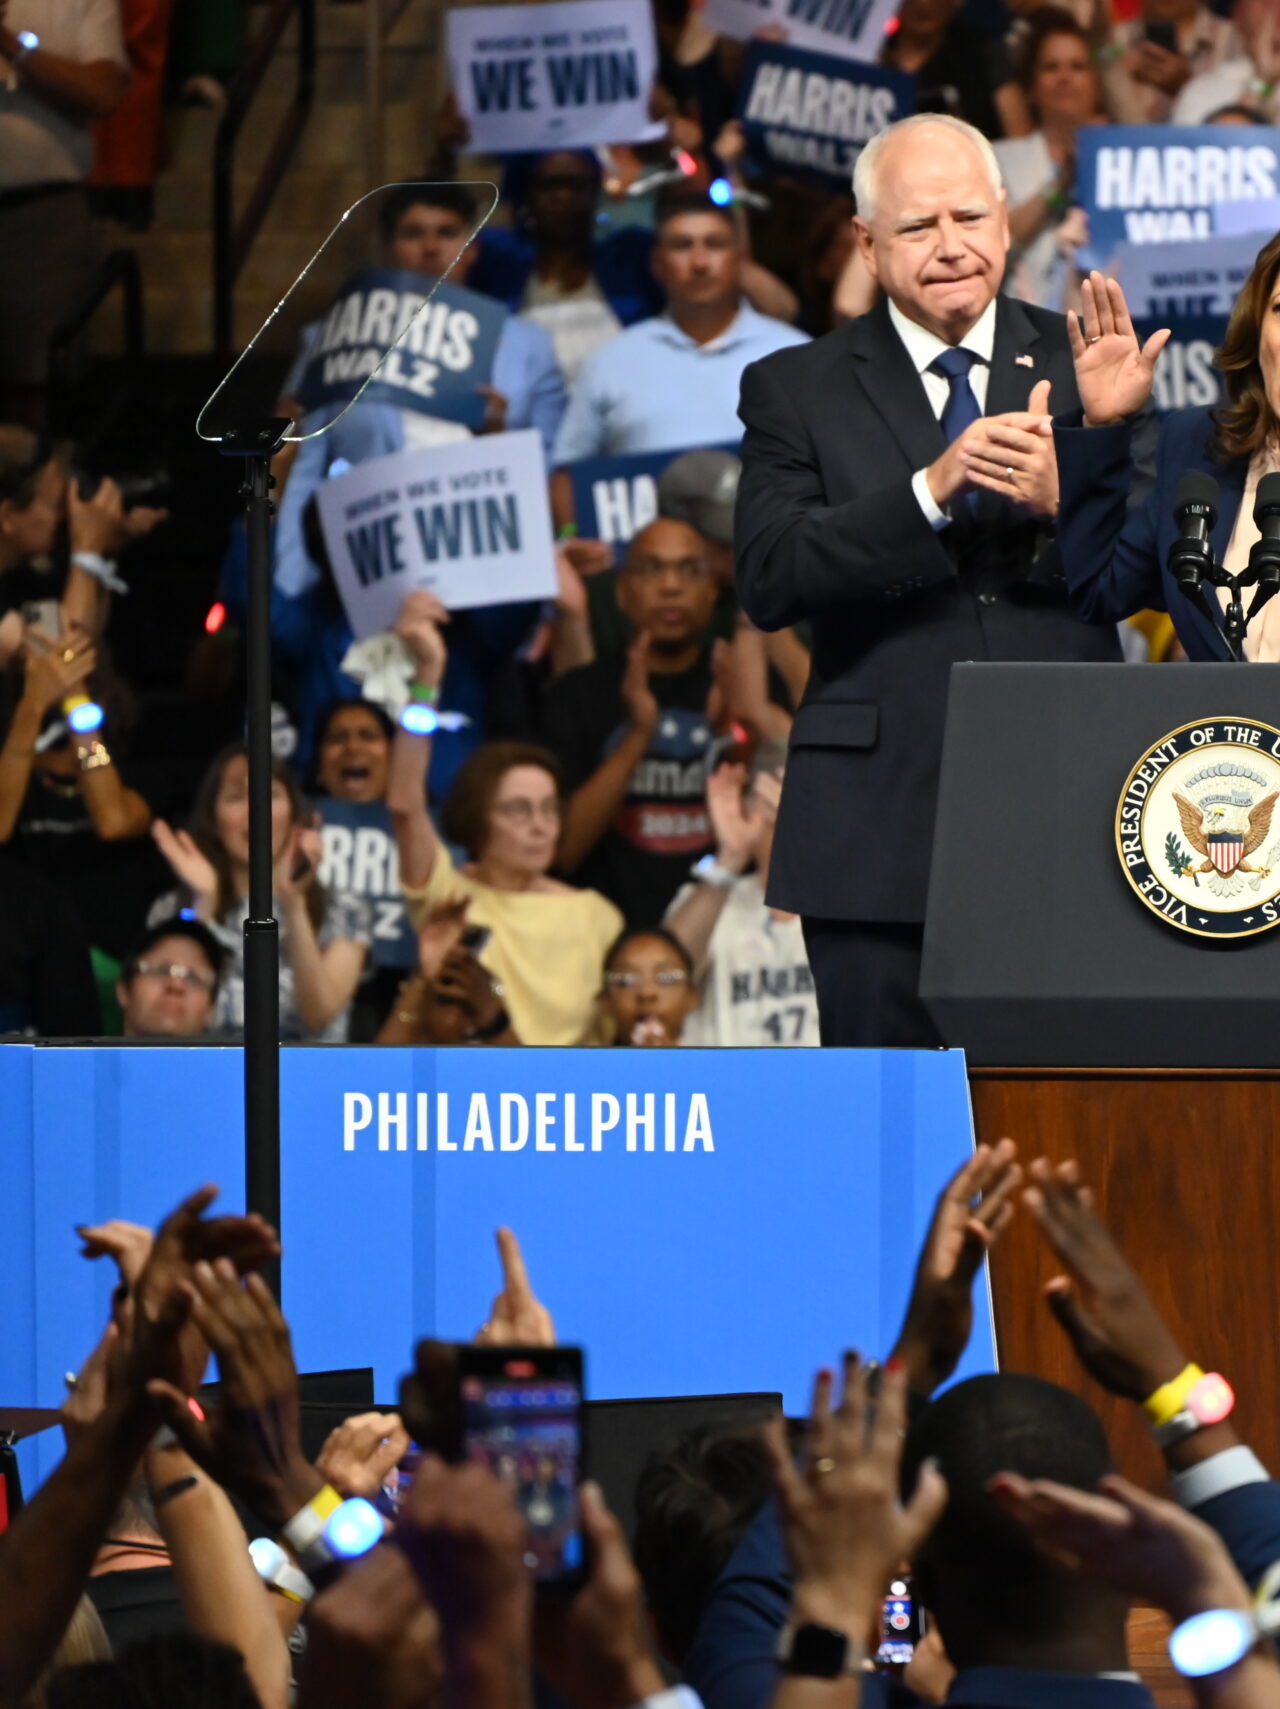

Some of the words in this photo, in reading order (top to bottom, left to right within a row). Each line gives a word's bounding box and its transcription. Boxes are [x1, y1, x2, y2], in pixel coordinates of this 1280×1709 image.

[471, 56, 538, 113] WE
[546, 48, 641, 107] WIN
[745, 61, 897, 142] HARRIS
[1095, 144, 1278, 210] HARRIS
[1123, 209, 1211, 245] WAL
[406, 478, 440, 498] WE
[344, 511, 405, 588] WE
[413, 494, 522, 563] WIN
[1190, 727, 1215, 746] OF
[1223, 726, 1262, 747] THE
[1120, 738, 1179, 868] PRESIDENT
[1138, 874, 1188, 926] VICE
[343, 1091, 715, 1152] PHILADELPHIA
